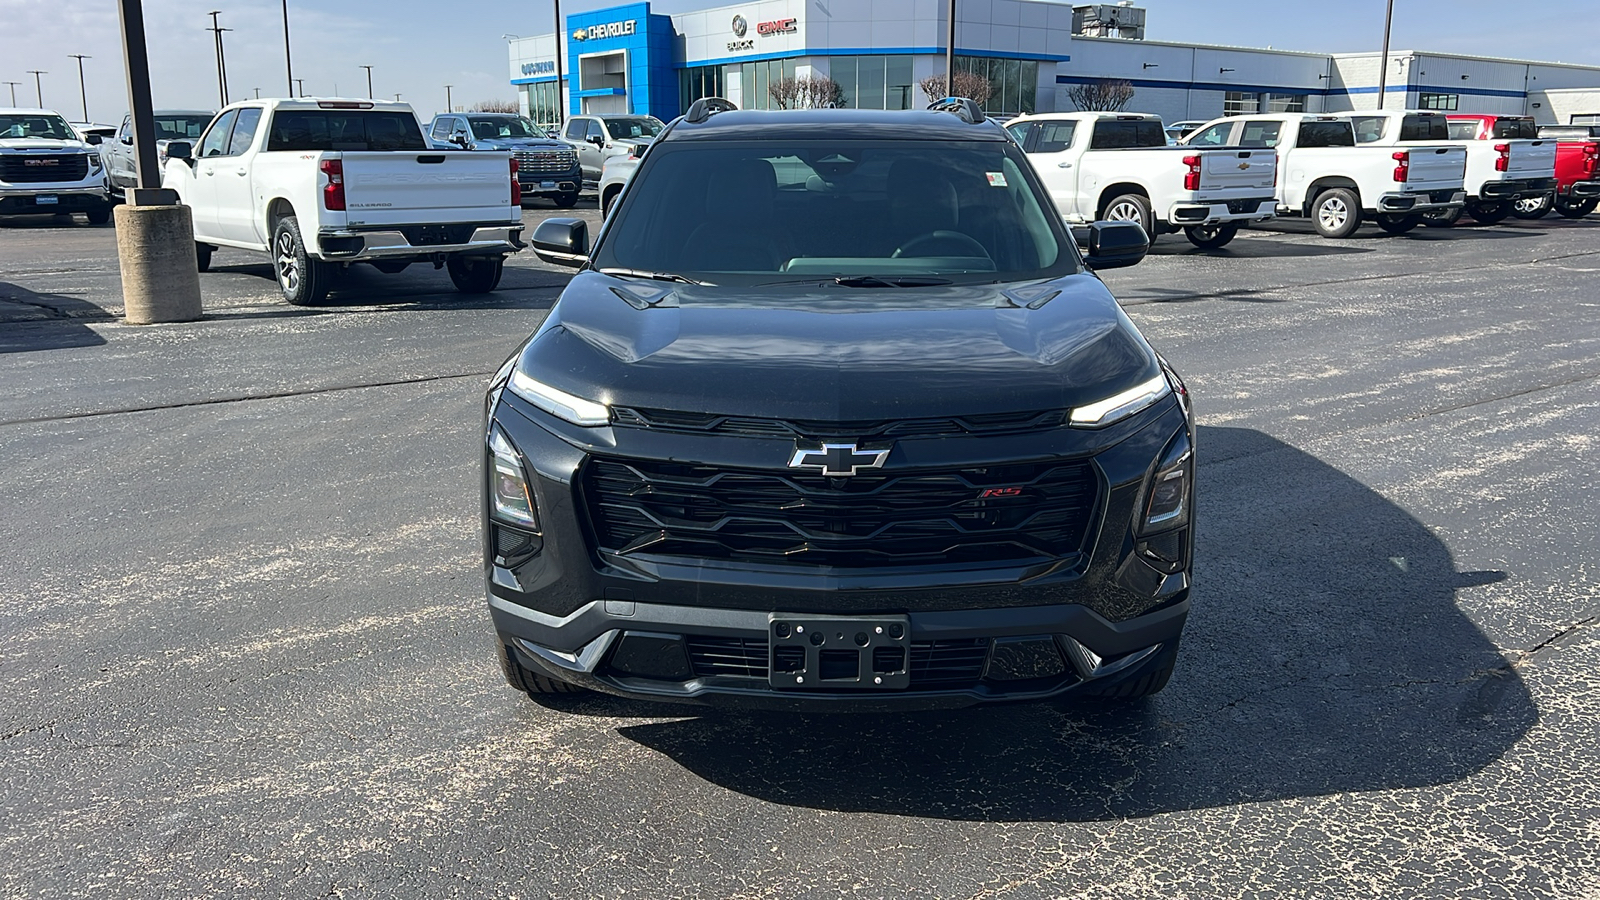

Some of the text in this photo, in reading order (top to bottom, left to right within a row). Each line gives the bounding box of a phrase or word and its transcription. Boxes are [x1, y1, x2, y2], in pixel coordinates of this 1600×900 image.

[588, 19, 637, 39] CHEVROLET
[757, 18, 796, 34] GMC
[727, 40, 754, 51] BUICK
[24, 159, 59, 167] GMC
[979, 486, 1022, 498] RS
